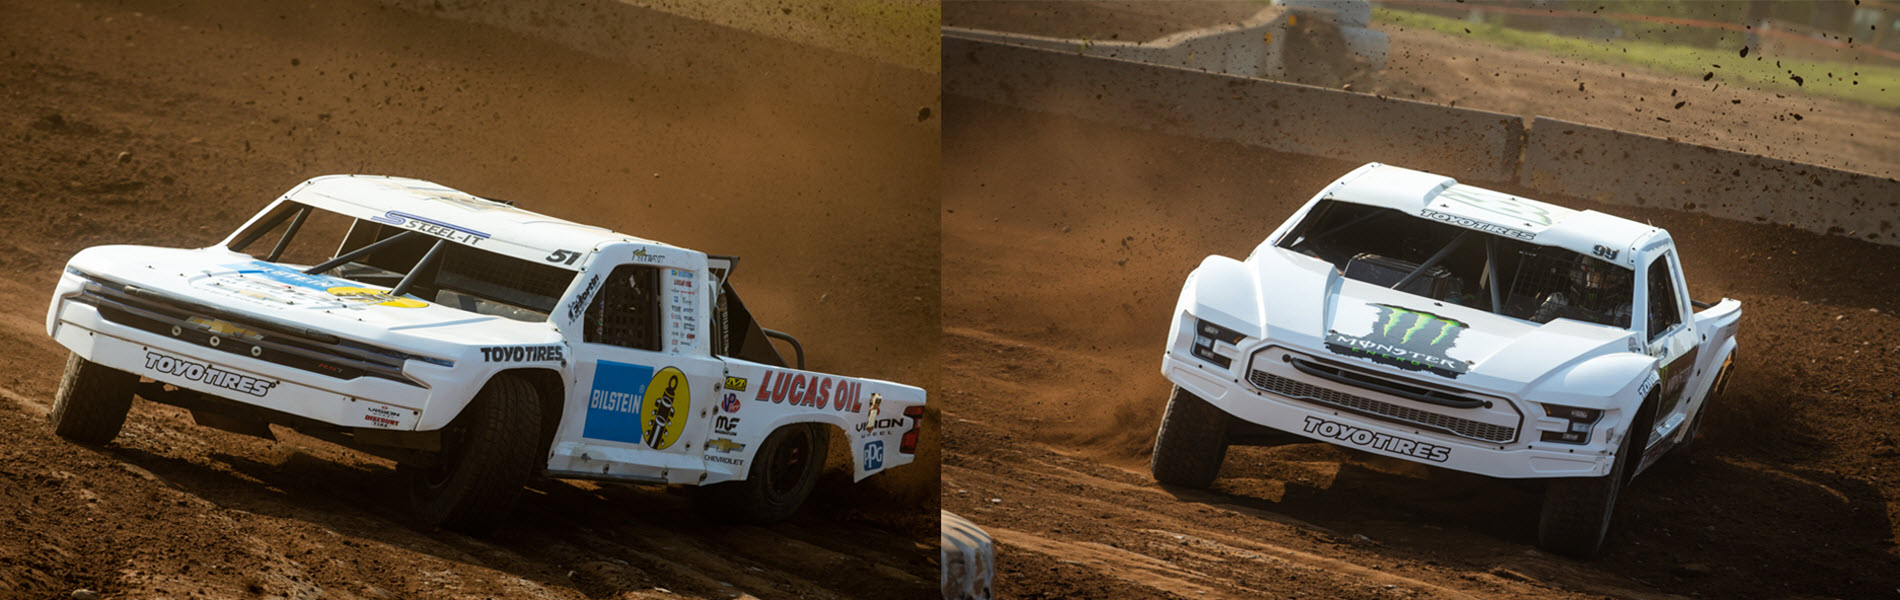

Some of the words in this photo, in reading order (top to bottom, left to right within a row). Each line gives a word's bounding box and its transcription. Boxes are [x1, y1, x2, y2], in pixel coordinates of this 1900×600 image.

[405, 220, 484, 246] STEEL-IT
[545, 249, 583, 266] 51
[1337, 336, 1456, 369] MONSTER
[1351, 347, 1434, 368] ENERGY
[590, 389, 642, 414] BILSTEIN
[755, 370, 832, 409] LUCAS
[833, 380, 862, 413] OIL
[365, 414, 399, 426] DISCOUNT
[856, 418, 904, 432] VIION
[704, 454, 745, 466] CHEVROLET
